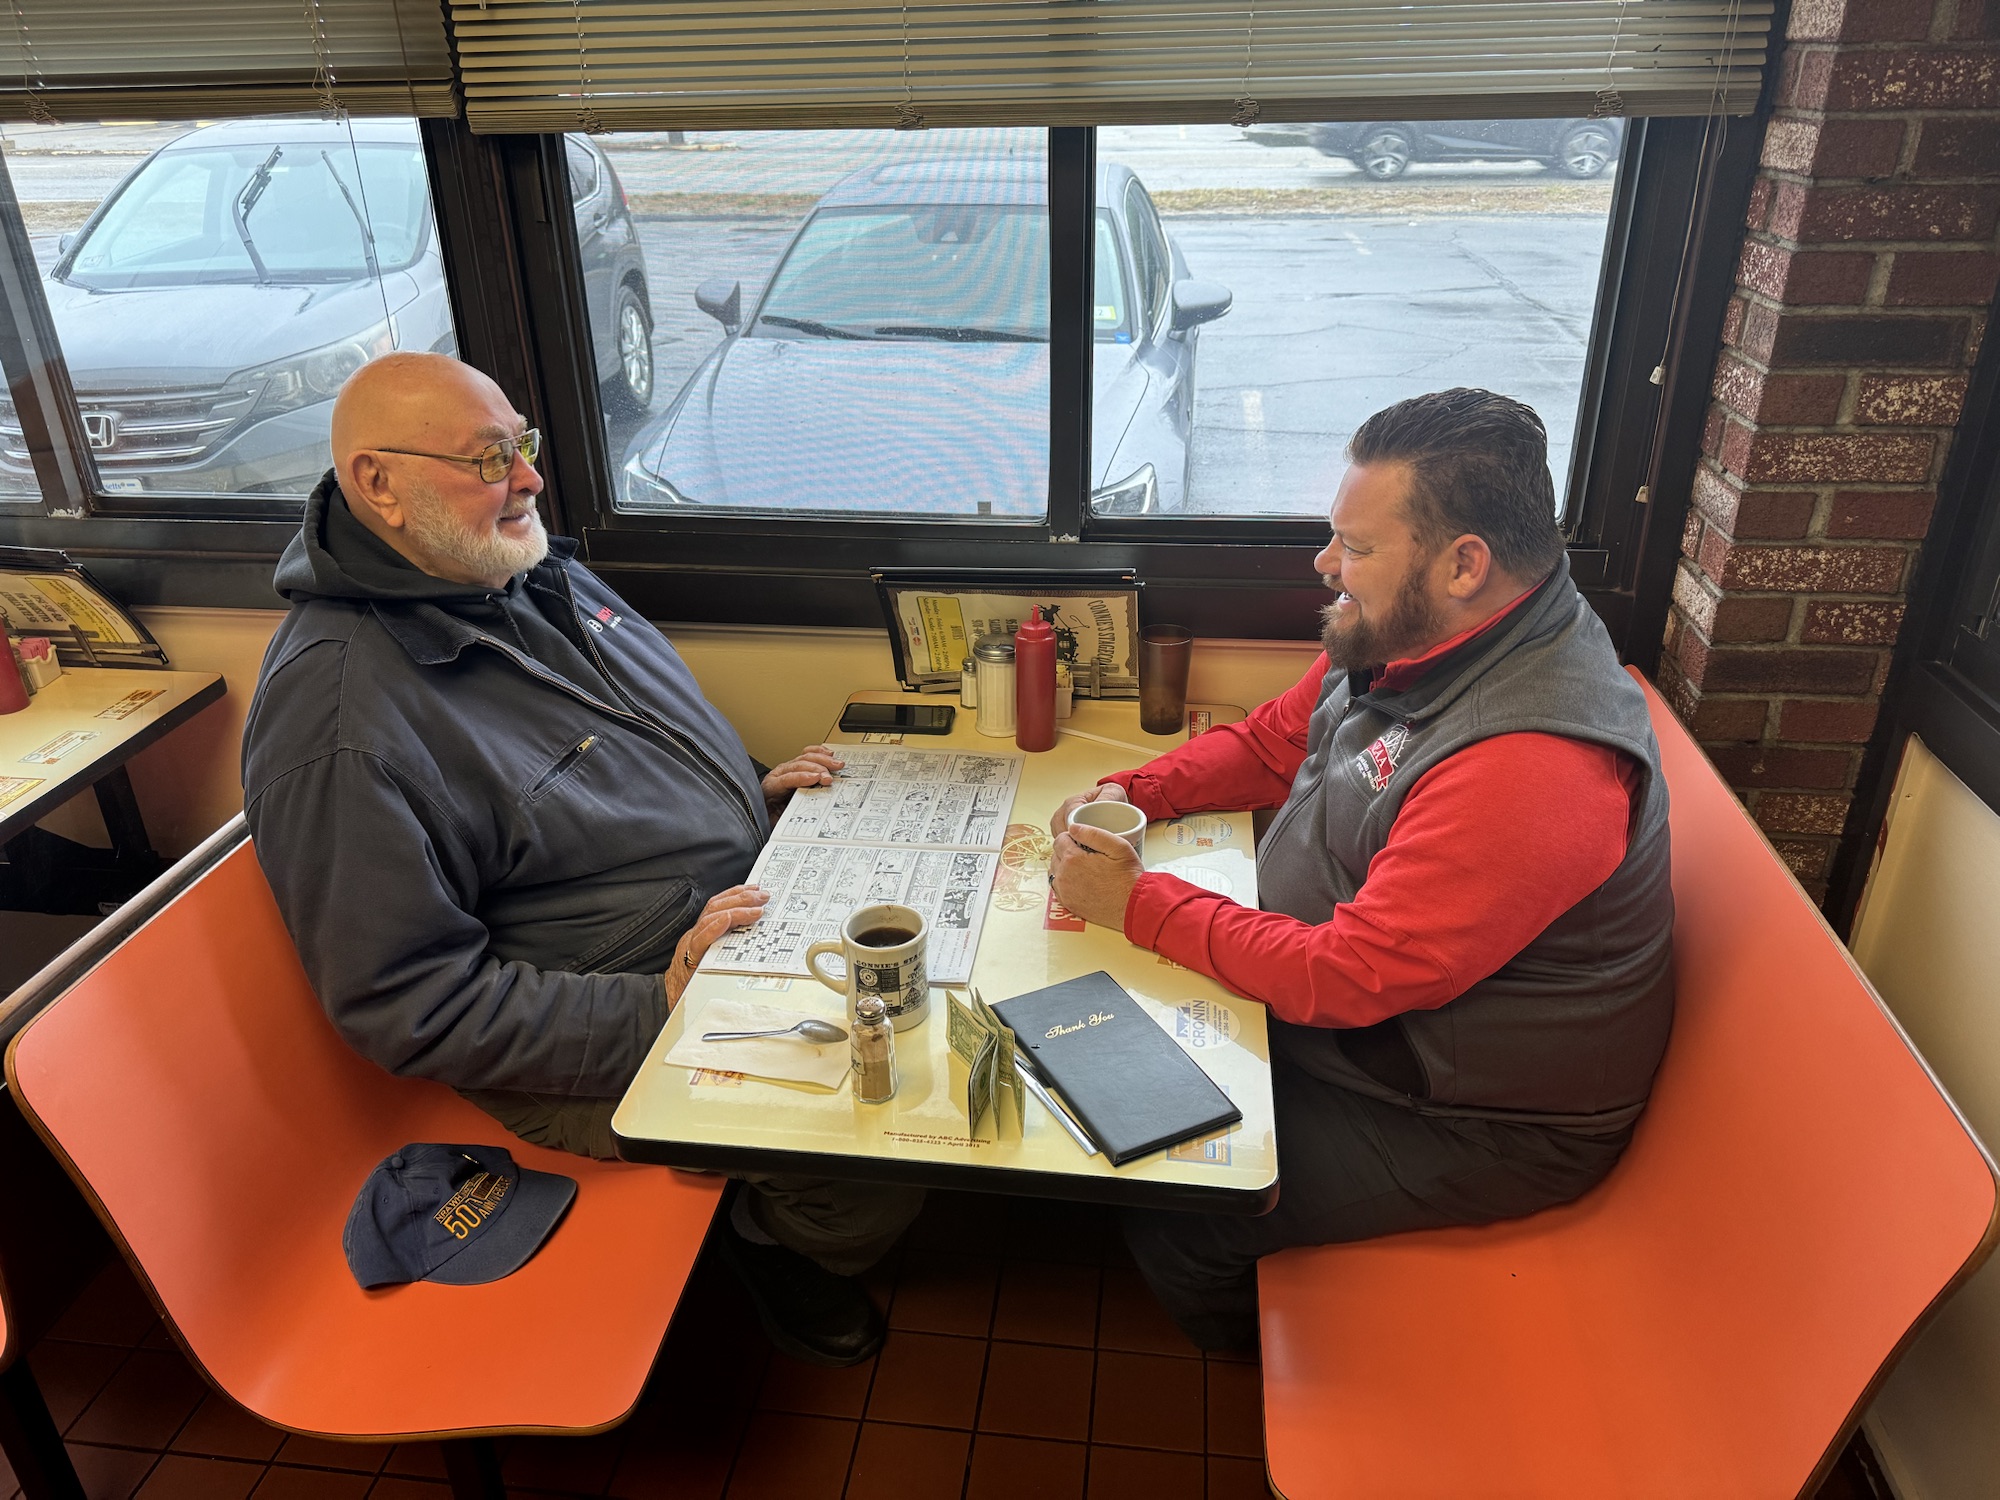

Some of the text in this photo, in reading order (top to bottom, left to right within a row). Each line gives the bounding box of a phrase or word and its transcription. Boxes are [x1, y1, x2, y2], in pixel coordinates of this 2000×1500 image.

[1088, 600, 1115, 664] CONNIE'S STAGECO
[856, 959, 899, 969] CONNIE'S
[1045, 1011, 1115, 1039] Thank You
[1193, 1000, 1205, 1048] CRONIN
[883, 1131, 928, 1139] Manufactured
[954, 1136, 991, 1144] Advertising
